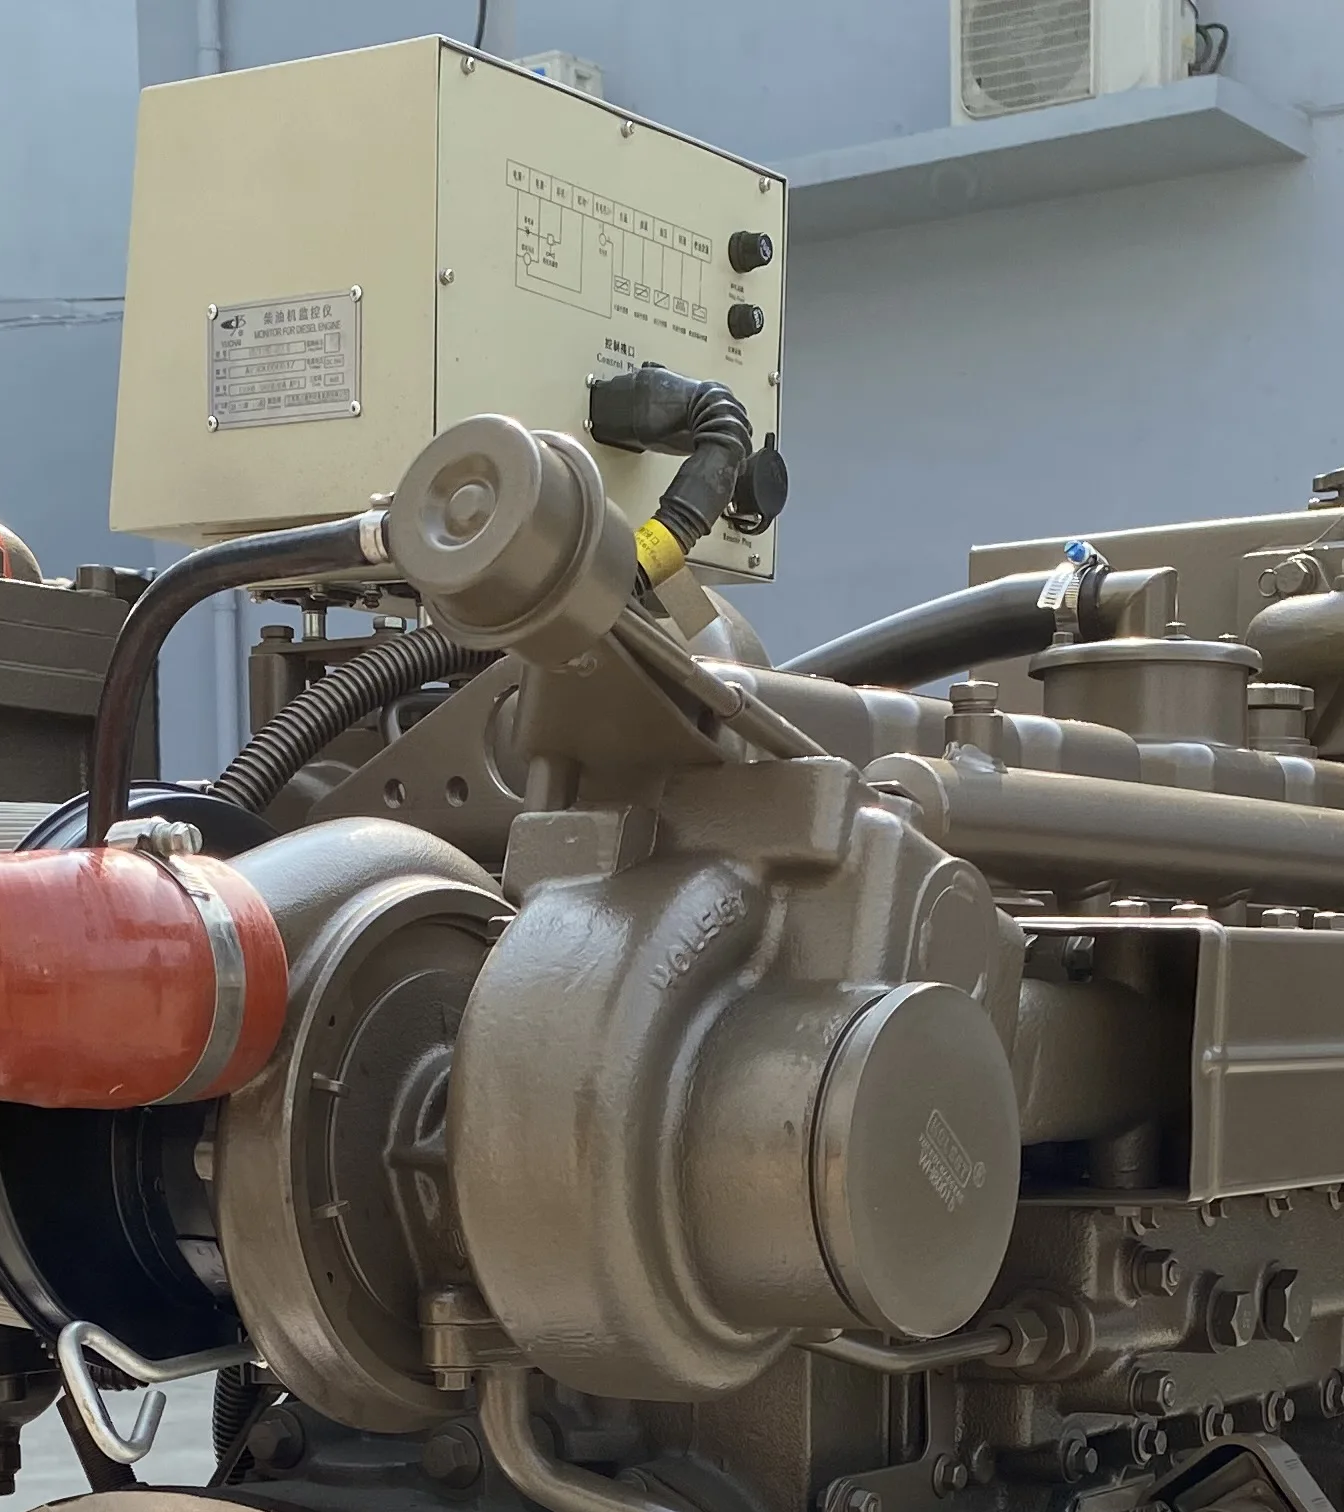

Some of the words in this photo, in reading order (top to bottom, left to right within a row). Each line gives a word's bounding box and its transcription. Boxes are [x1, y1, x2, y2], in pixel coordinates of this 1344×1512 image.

[264, 305, 332, 325] 柴油机监控仪
[254, 326, 283, 340] MONITOR
[283, 325, 296, 336] FOR
[296, 323, 318, 335] DIESEL
[318, 320, 341, 330] ENGINE
[597, 353, 623, 369] Control
